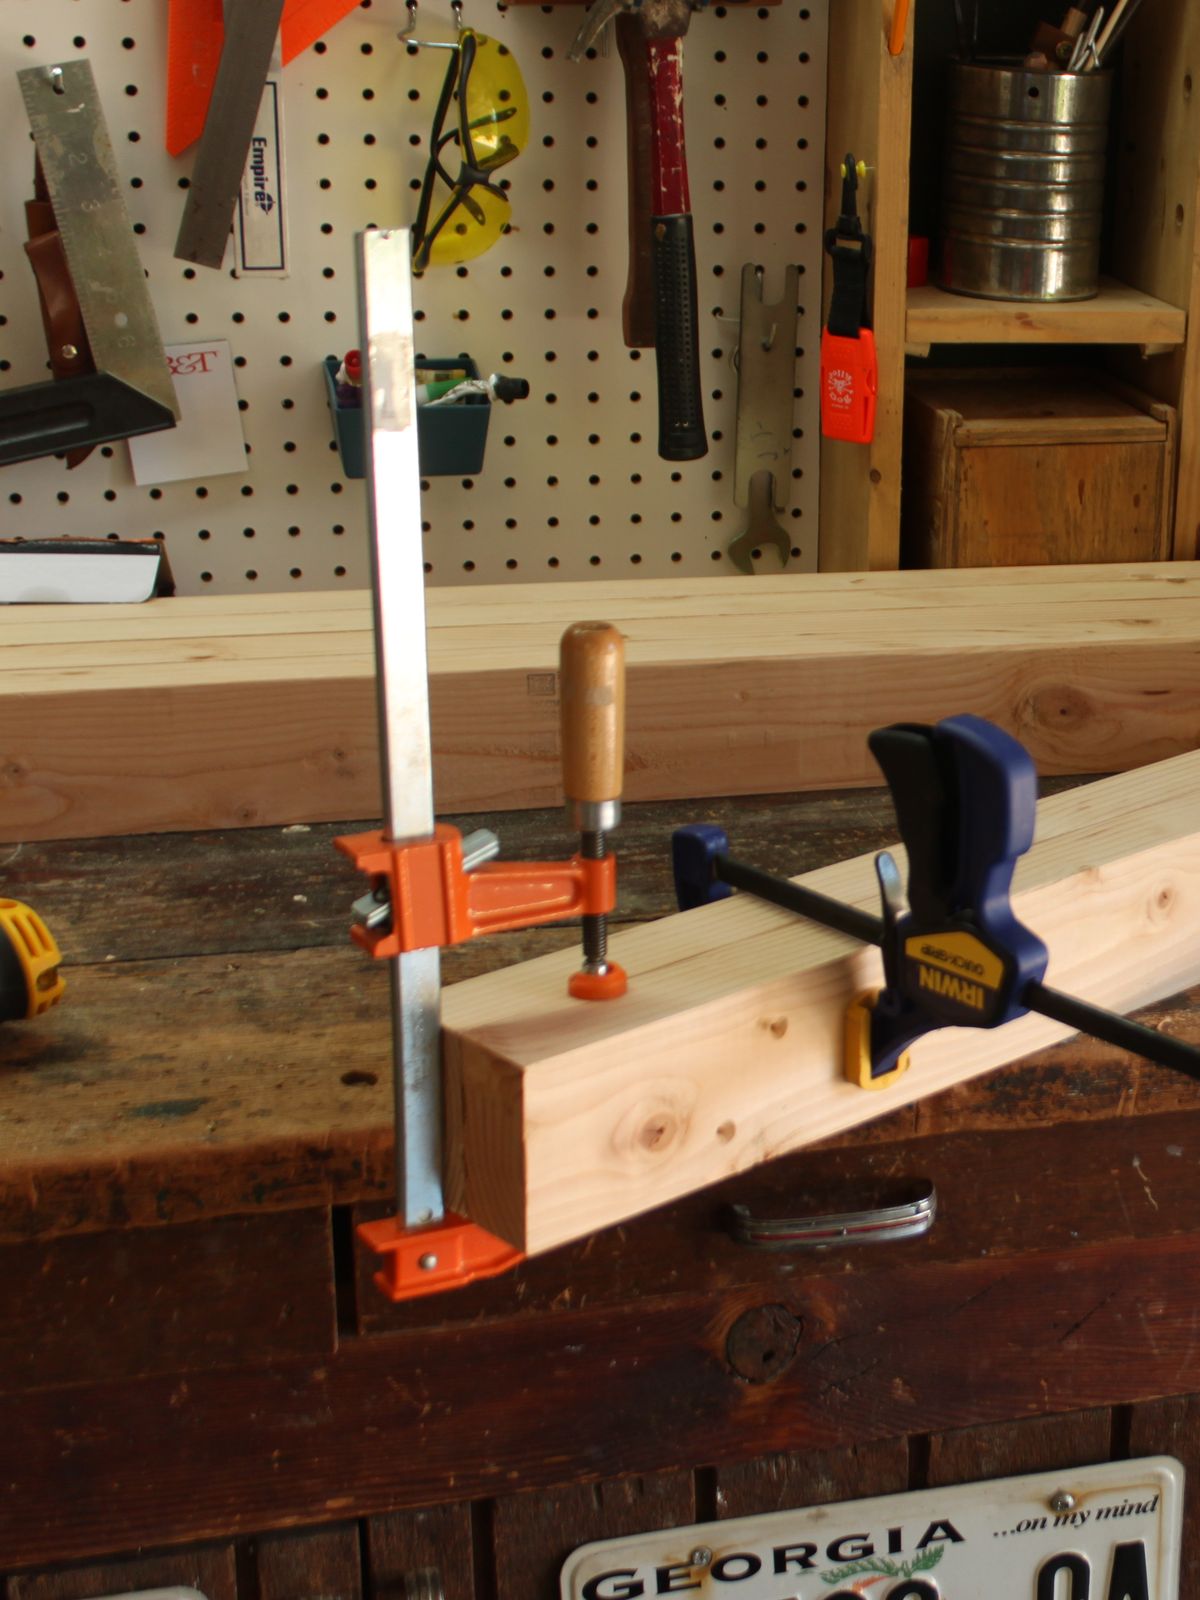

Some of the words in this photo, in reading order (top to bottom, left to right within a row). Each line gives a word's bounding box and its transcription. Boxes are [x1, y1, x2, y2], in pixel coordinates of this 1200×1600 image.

[250, 137, 268, 202] Empire
[919, 963, 984, 1009] IRWIN
[1053, 1508, 1092, 1529] my
[1095, 1494, 1160, 1521] mind
[581, 1518, 966, 1600] GEORGIA
